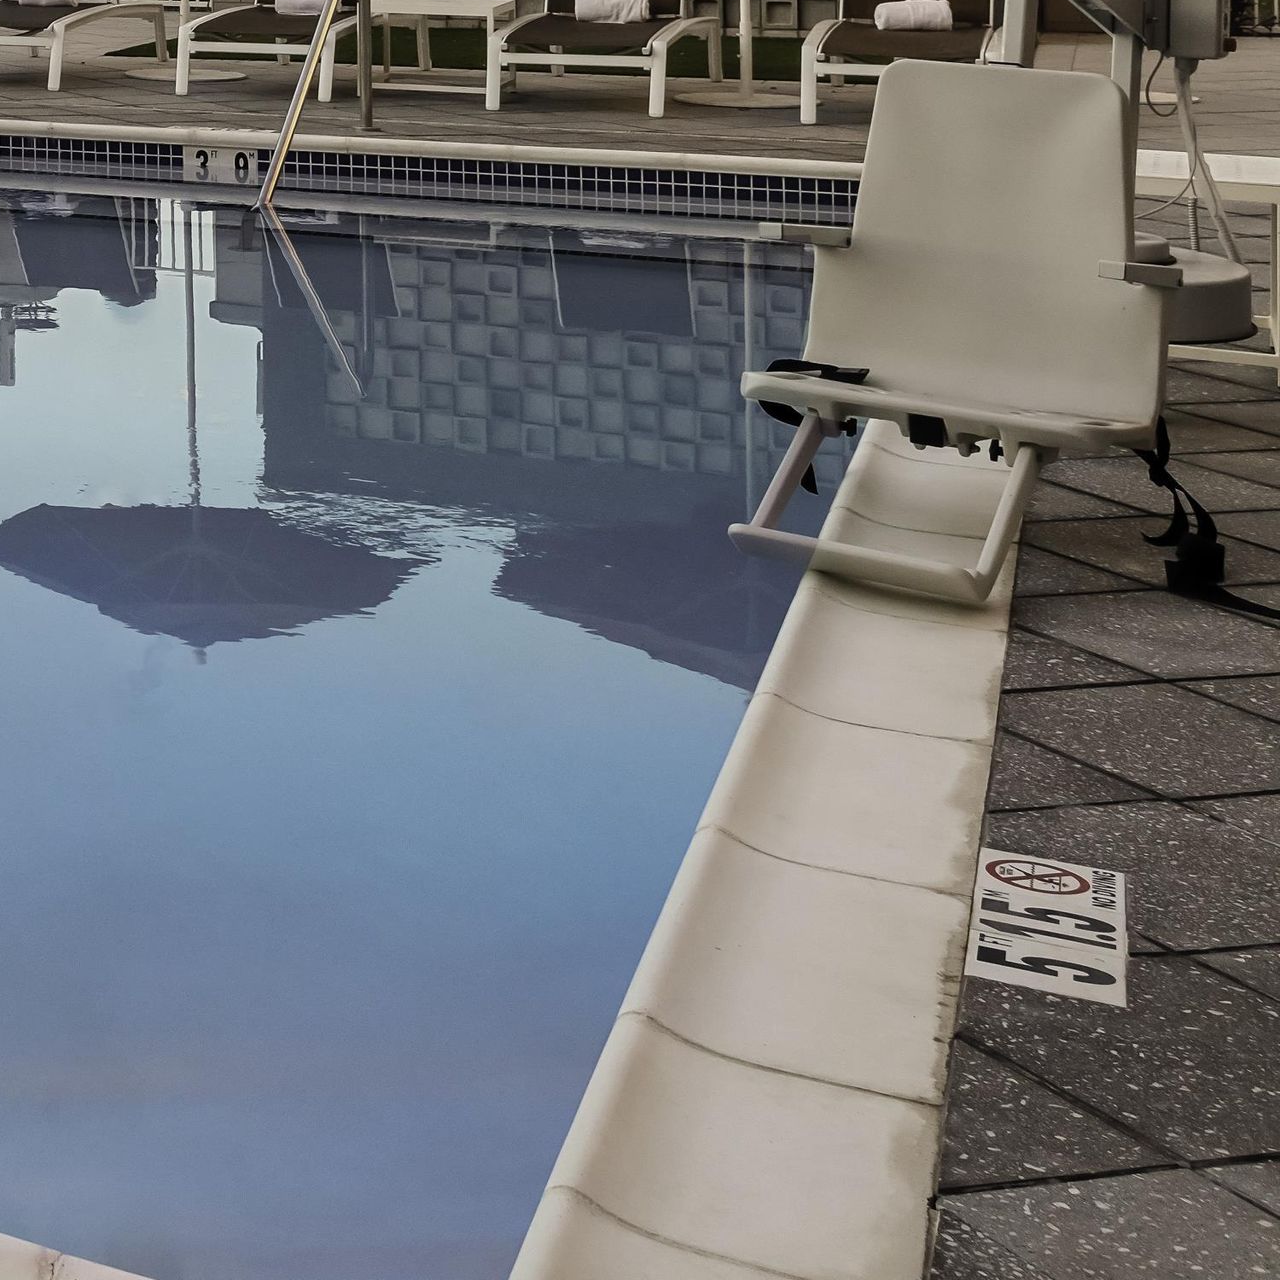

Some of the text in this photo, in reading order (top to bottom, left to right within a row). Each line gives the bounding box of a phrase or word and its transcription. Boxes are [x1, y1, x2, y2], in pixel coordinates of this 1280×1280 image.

[1091, 870, 1117, 910] NO DIVING
[977, 888, 1117, 985] 5 FT 1.5 M
